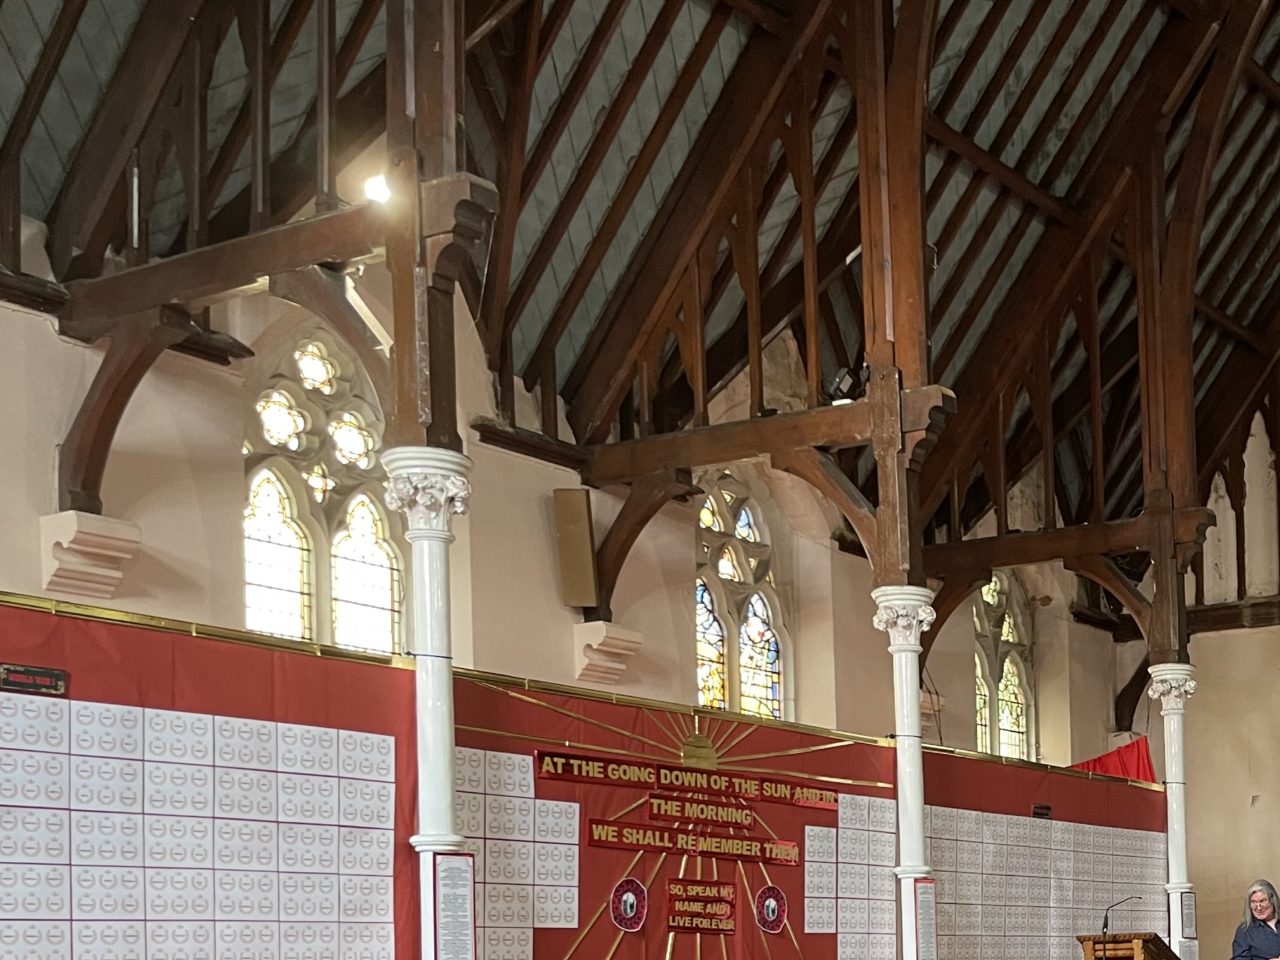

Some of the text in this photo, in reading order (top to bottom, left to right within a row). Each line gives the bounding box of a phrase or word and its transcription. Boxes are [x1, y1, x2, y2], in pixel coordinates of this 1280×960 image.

[542, 756, 565, 774] AT
[570, 759, 604, 778] THE
[607, 764, 655, 783] GOING
[660, 769, 707, 788] DOWN
[710, 775, 728, 790] OF
[732, 778, 759, 794] THE
[762, 782, 790, 799] SUN
[794, 787, 820, 803] AND
[651, 799, 751, 825] THE MORNING
[592, 824, 618, 842] WE
[622, 828, 673, 848] SHALL
[763, 843, 799, 861] THEM
[669, 884, 734, 898] SO, SPEAK MY
[675, 900, 704, 912] NAME
[706, 902, 725, 914] AND
[669, 915, 735, 930] LIVE FOREVER
